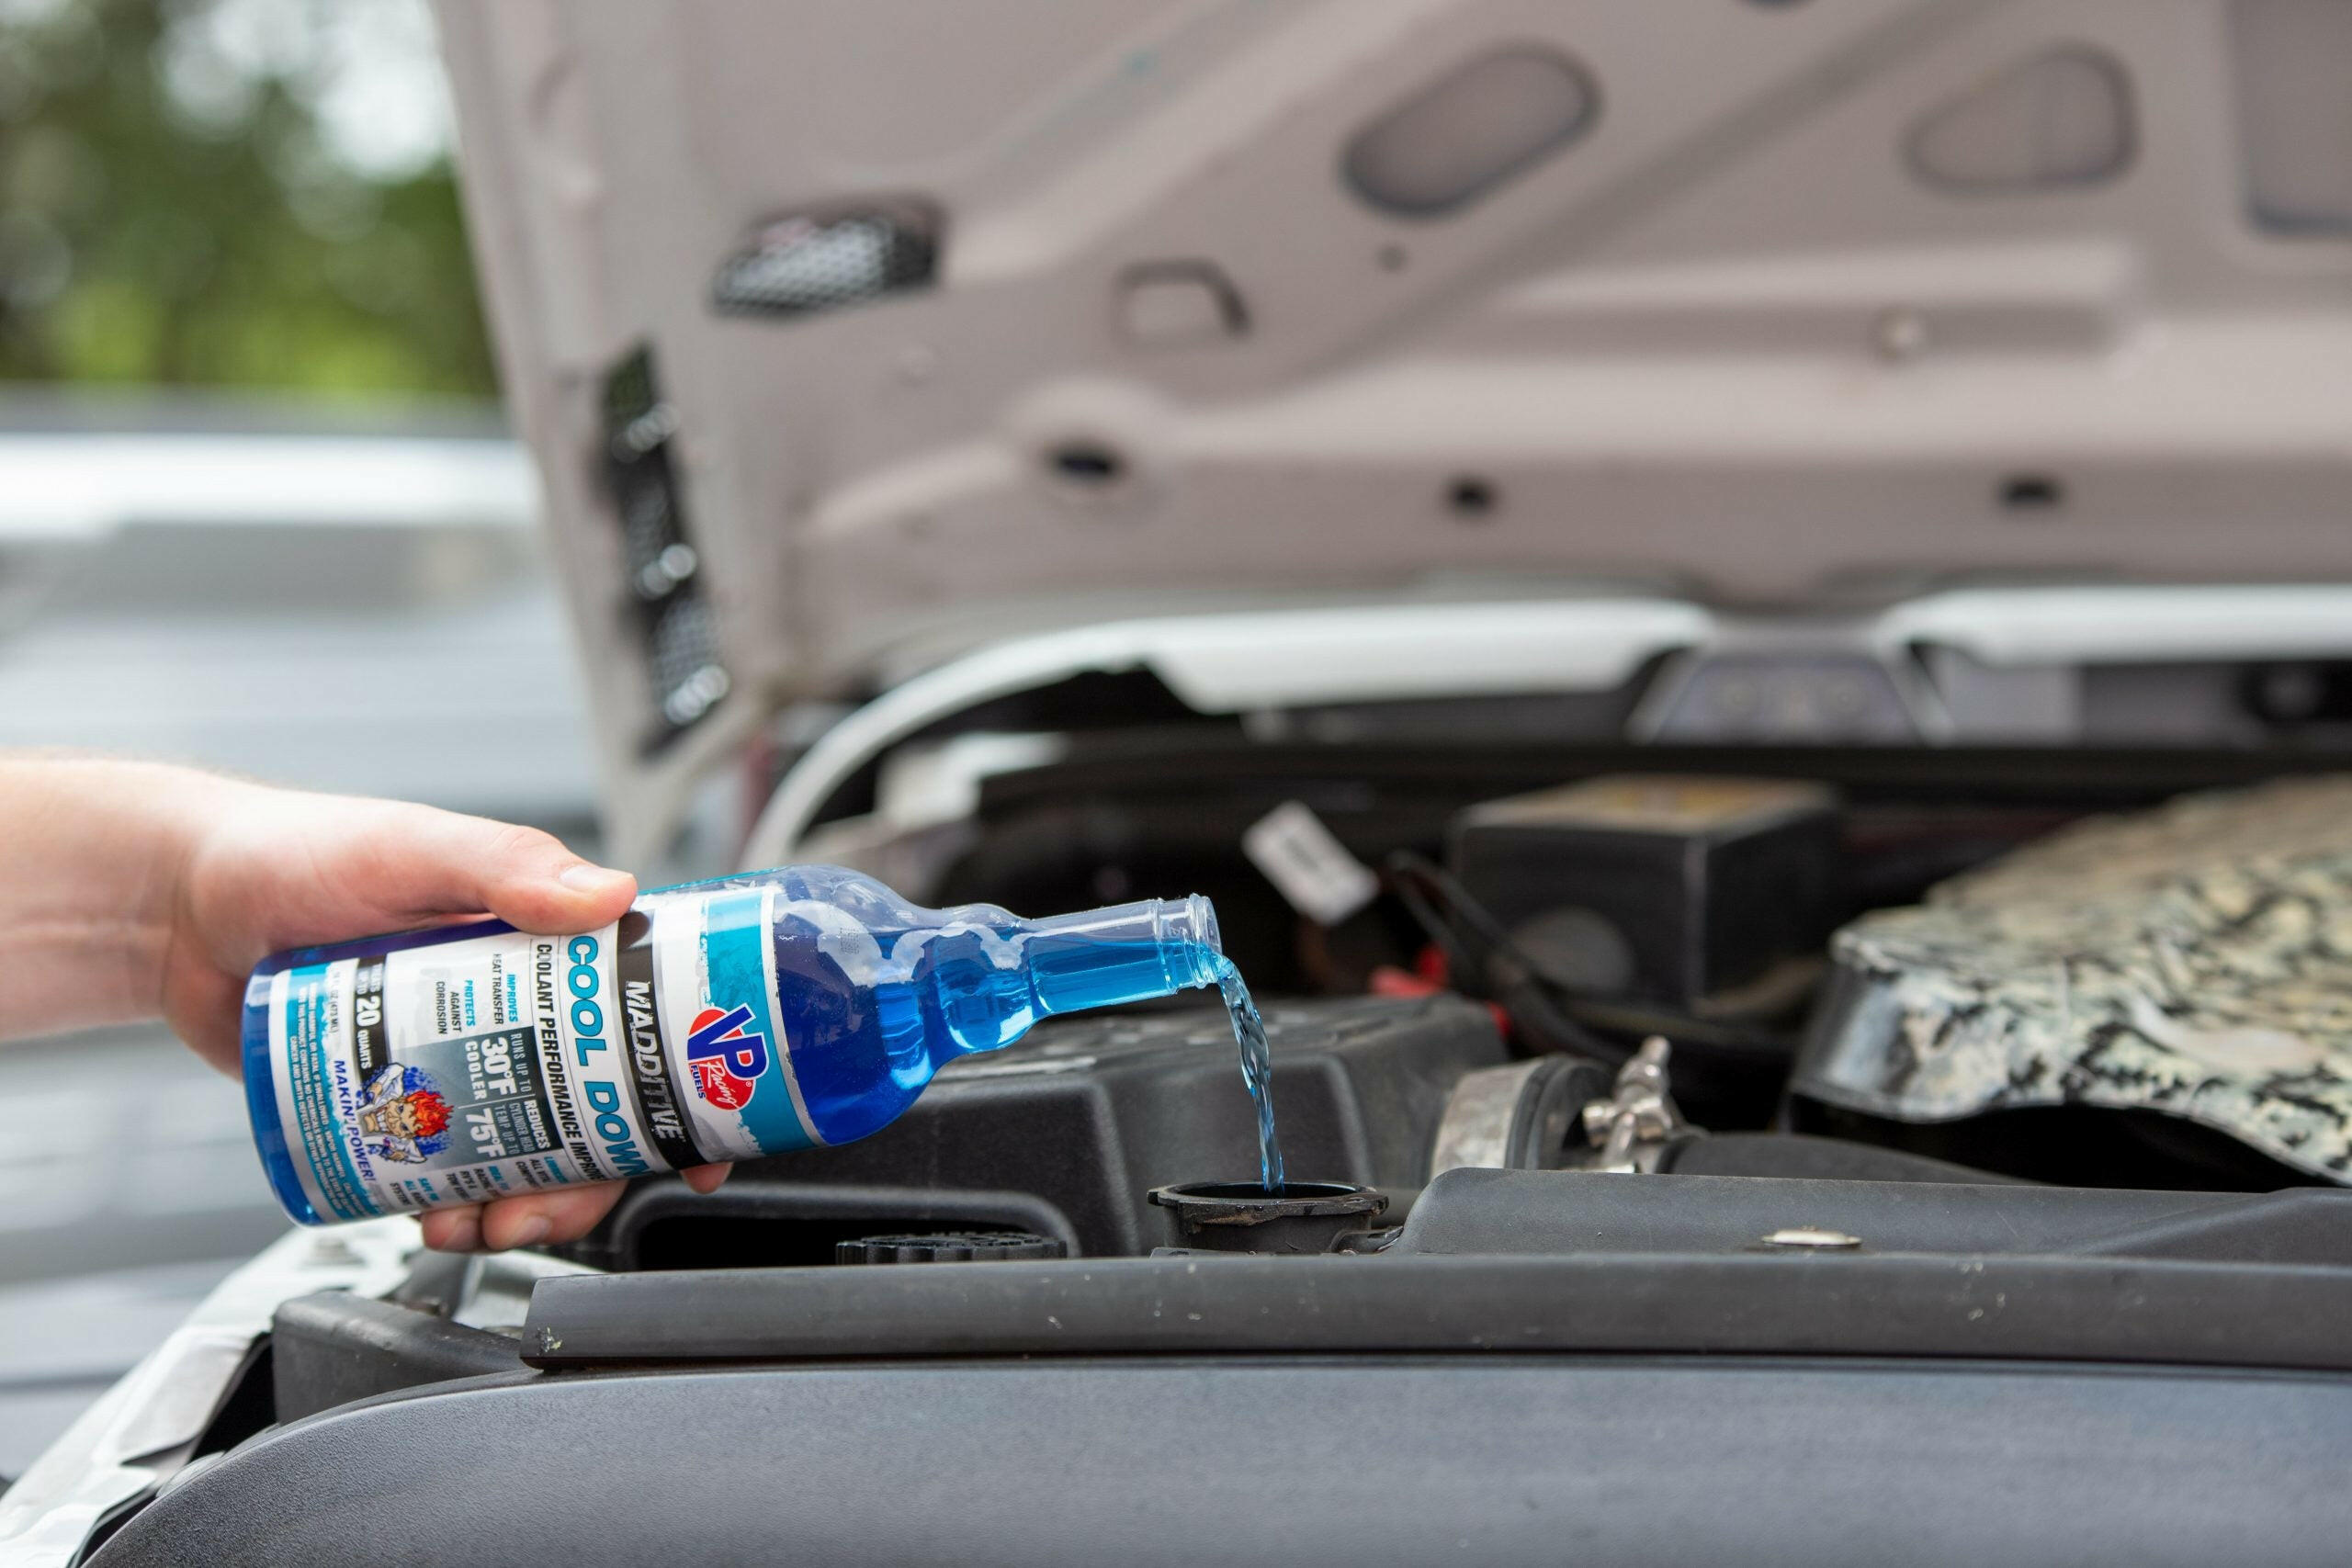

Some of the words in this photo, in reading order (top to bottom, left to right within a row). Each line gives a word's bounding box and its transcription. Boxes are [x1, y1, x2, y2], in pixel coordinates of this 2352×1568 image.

[492, 977, 504, 1025] TRANSFER
[506, 974, 518, 1022] IMPROVES
[537, 944, 554, 1012] COOLANT
[568, 935, 607, 1066] COOL
[356, 995, 381, 1027] 20
[435, 981, 447, 1034] CORROSION
[450, 991, 462, 1032] AGAINST
[464, 979, 475, 1027] PROTECTS
[356, 1029, 372, 1069] QUARTS
[511, 1032, 525, 1060] RUNS
[626, 980, 684, 1140] MADDITIVE
[687, 1003, 769, 1079] VP
[300, 1049, 311, 1084] CONTAINS
[465, 1041, 487, 1100] COOLER
[481, 1036, 517, 1096] 30°F
[515, 1063, 529, 1076] UP
[519, 1079, 532, 1093] TO
[539, 1017, 582, 1139] PERFORMANCE
[691, 1065, 706, 1099] FUELS
[699, 1061, 740, 1108] Racing
[314, 1082, 330, 1125] SWALLOWED
[334, 1060, 356, 1122] MAKIN'
[346, 1126, 377, 1181] POWER!
[494, 1104, 511, 1129] TEMP
[509, 1102, 529, 1135] CYLINDER
[520, 1136, 536, 1153] HEAD
[524, 1100, 550, 1149] REDUCES
[466, 1108, 507, 1157] 75°F
[502, 1131, 514, 1143] UP
[506, 1145, 521, 1155] TO
[569, 1142, 607, 1181] IMPROVE
